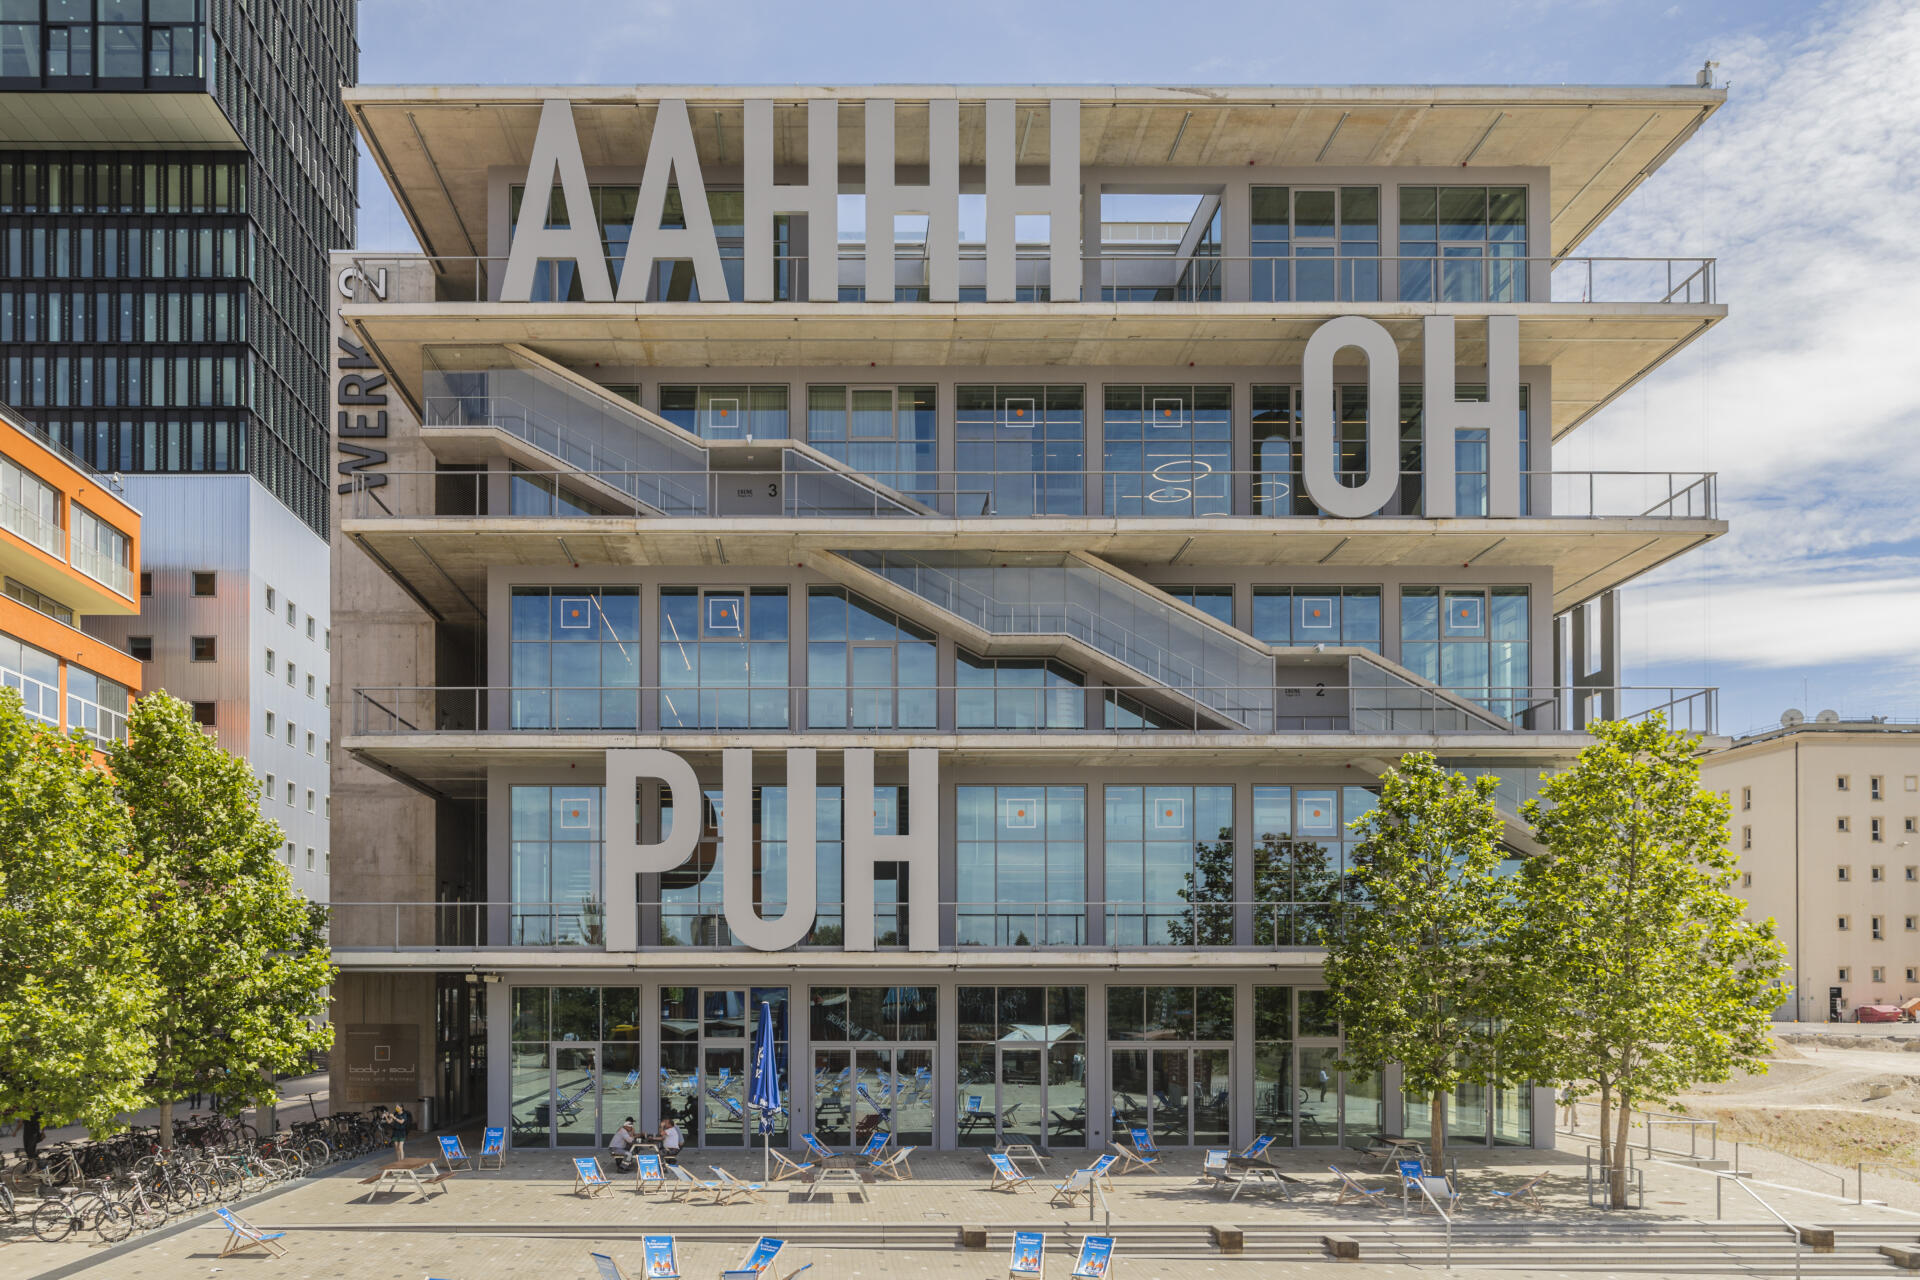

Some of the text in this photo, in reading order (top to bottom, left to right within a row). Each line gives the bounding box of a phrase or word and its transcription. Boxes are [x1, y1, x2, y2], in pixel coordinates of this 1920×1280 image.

[500, 99, 1081, 302] AAHHH
[337, 267, 388, 495] WERK 2
[1302, 315, 1519, 519] OH
[768, 483, 778, 497] 3
[1316, 683, 1325, 697] 2
[605, 748, 939, 952] PUH
[349, 1063, 380, 1077] body
[389, 1063, 415, 1073] soul
